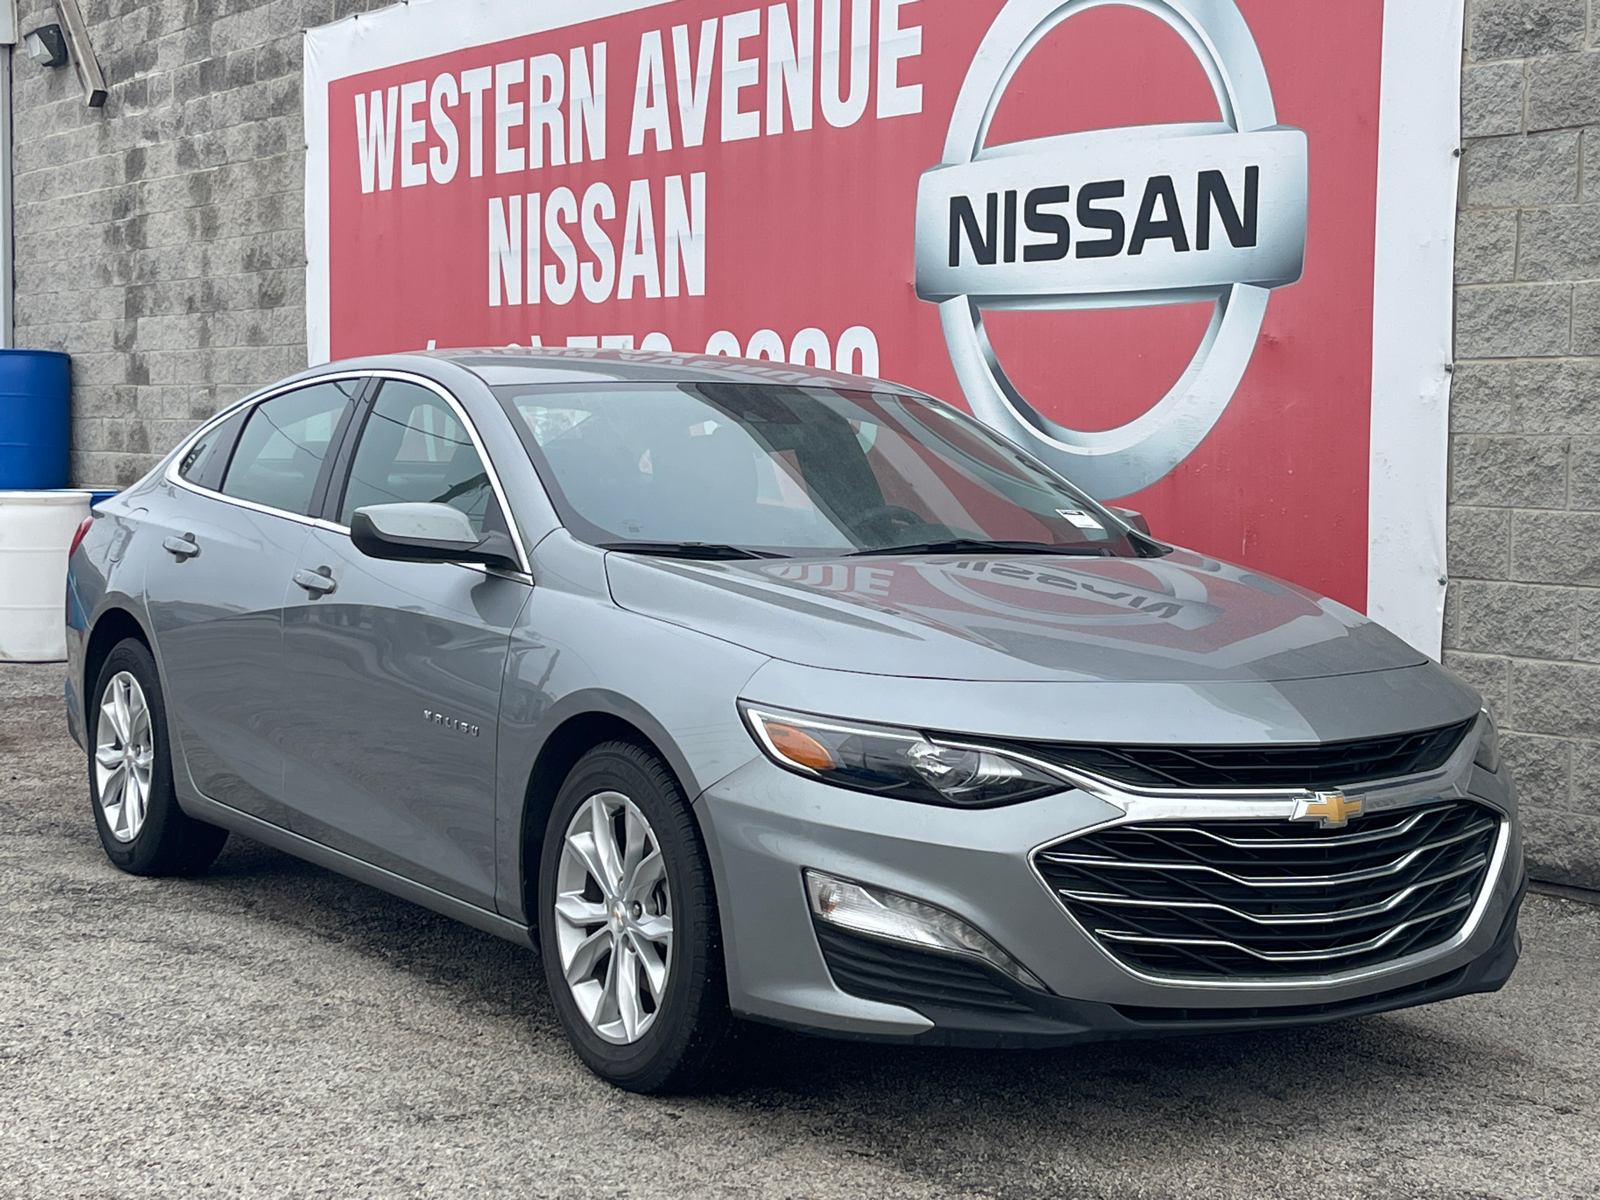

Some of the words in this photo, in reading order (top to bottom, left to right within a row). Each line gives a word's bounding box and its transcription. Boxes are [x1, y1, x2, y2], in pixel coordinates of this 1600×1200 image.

[354, 41, 607, 194] WESTERN
[628, 0, 923, 156] AVENUE
[488, 171, 706, 307] NISSAN
[948, 165, 1259, 268] NISSAN
[423, 709, 479, 736] MALIBU
